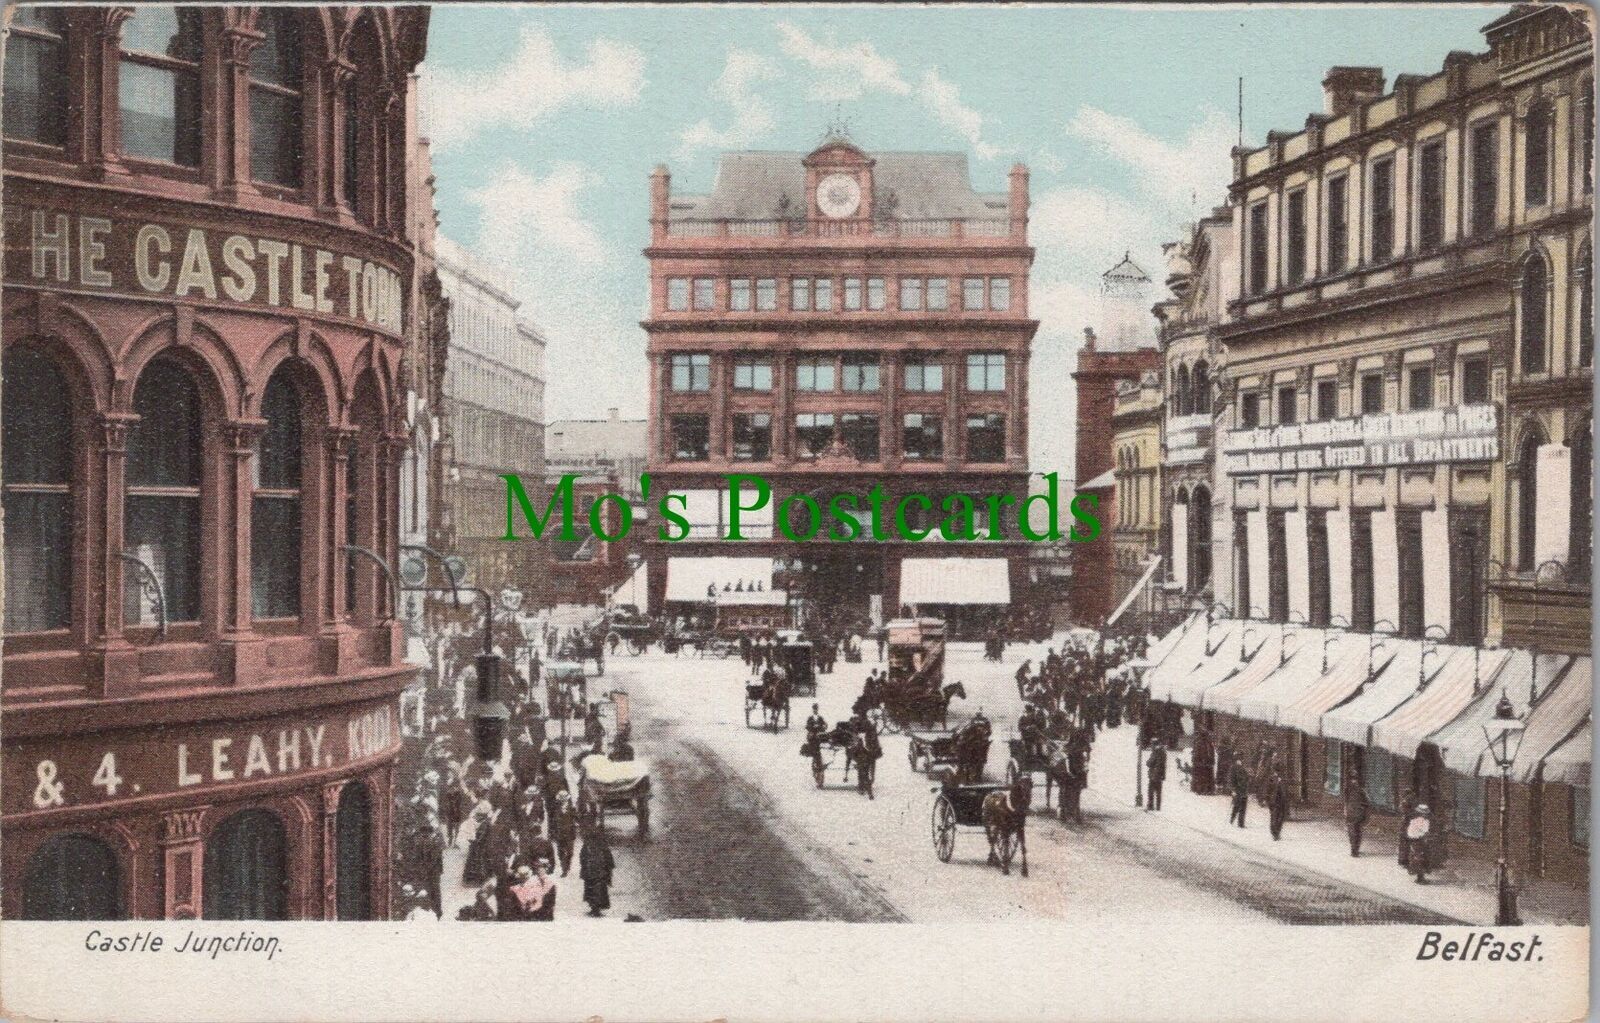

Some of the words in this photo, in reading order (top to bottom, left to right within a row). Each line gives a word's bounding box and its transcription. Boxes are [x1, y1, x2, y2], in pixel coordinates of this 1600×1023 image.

[135, 223, 334, 313] CASTLE
[1388, 442, 1408, 463] ALL
[1413, 436, 1498, 461] DEPARTMENTS
[34, 759, 64, 807] &
